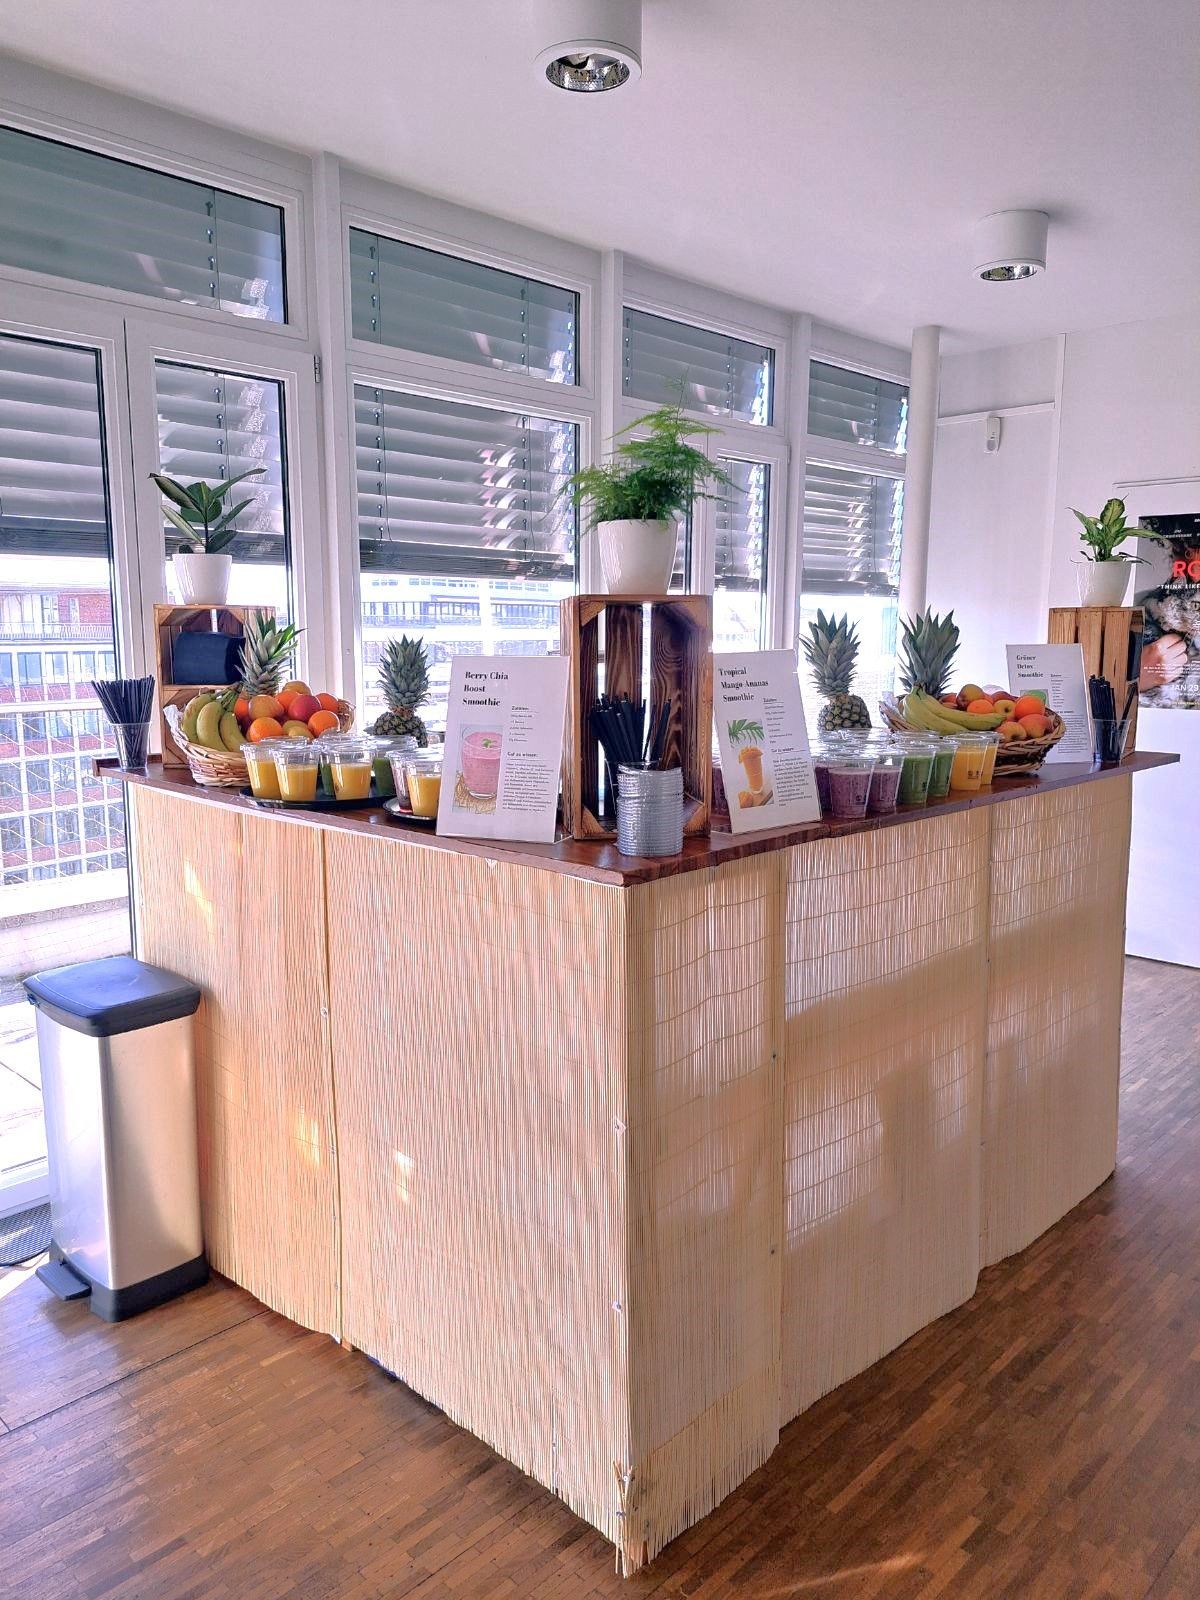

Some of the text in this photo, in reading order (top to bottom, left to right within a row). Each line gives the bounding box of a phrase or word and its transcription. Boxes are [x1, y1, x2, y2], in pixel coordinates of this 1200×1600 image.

[465, 671, 509, 681] Berry Chia
[718, 667, 747, 677] Tropical
[463, 684, 486, 692] Boost
[462, 697, 501, 706] Smoothie
[722, 692, 755, 702] Smoothie
